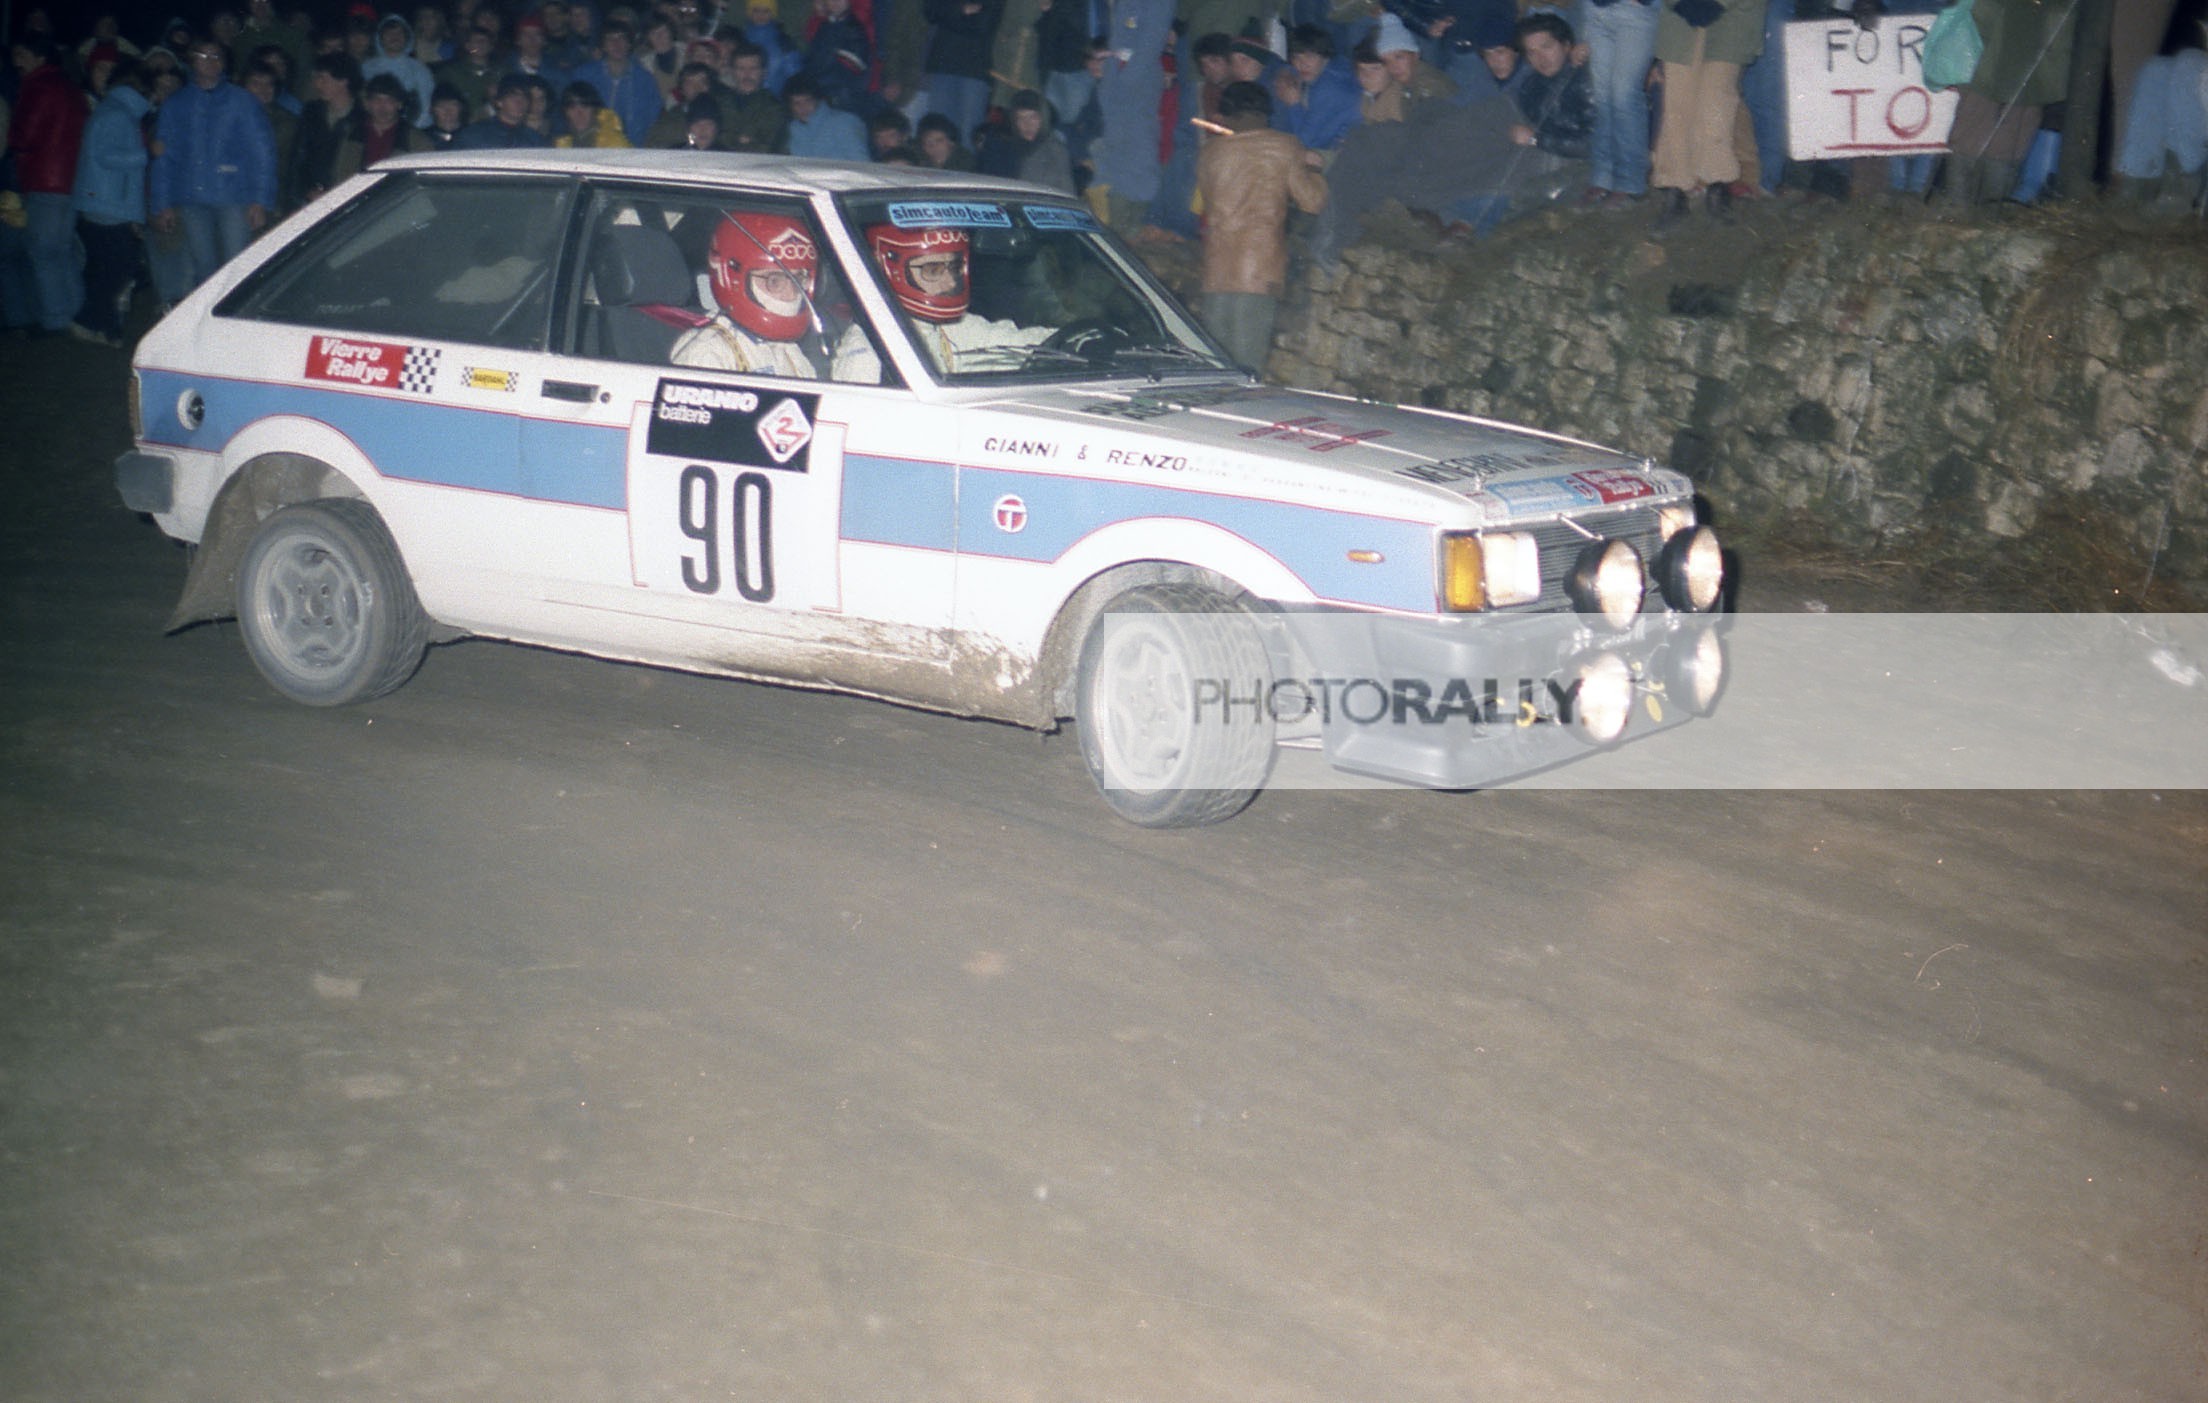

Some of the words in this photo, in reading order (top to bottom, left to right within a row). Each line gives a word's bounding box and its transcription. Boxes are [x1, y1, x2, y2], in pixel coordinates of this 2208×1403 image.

[1831, 86, 1958, 141] TO
[320, 338, 382, 361] Vierre
[326, 358, 390, 384] Rallye
[984, 437, 1058, 458] GIANNI
[1108, 449, 1188, 471] RENZO
[679, 464, 776, 603] 90
